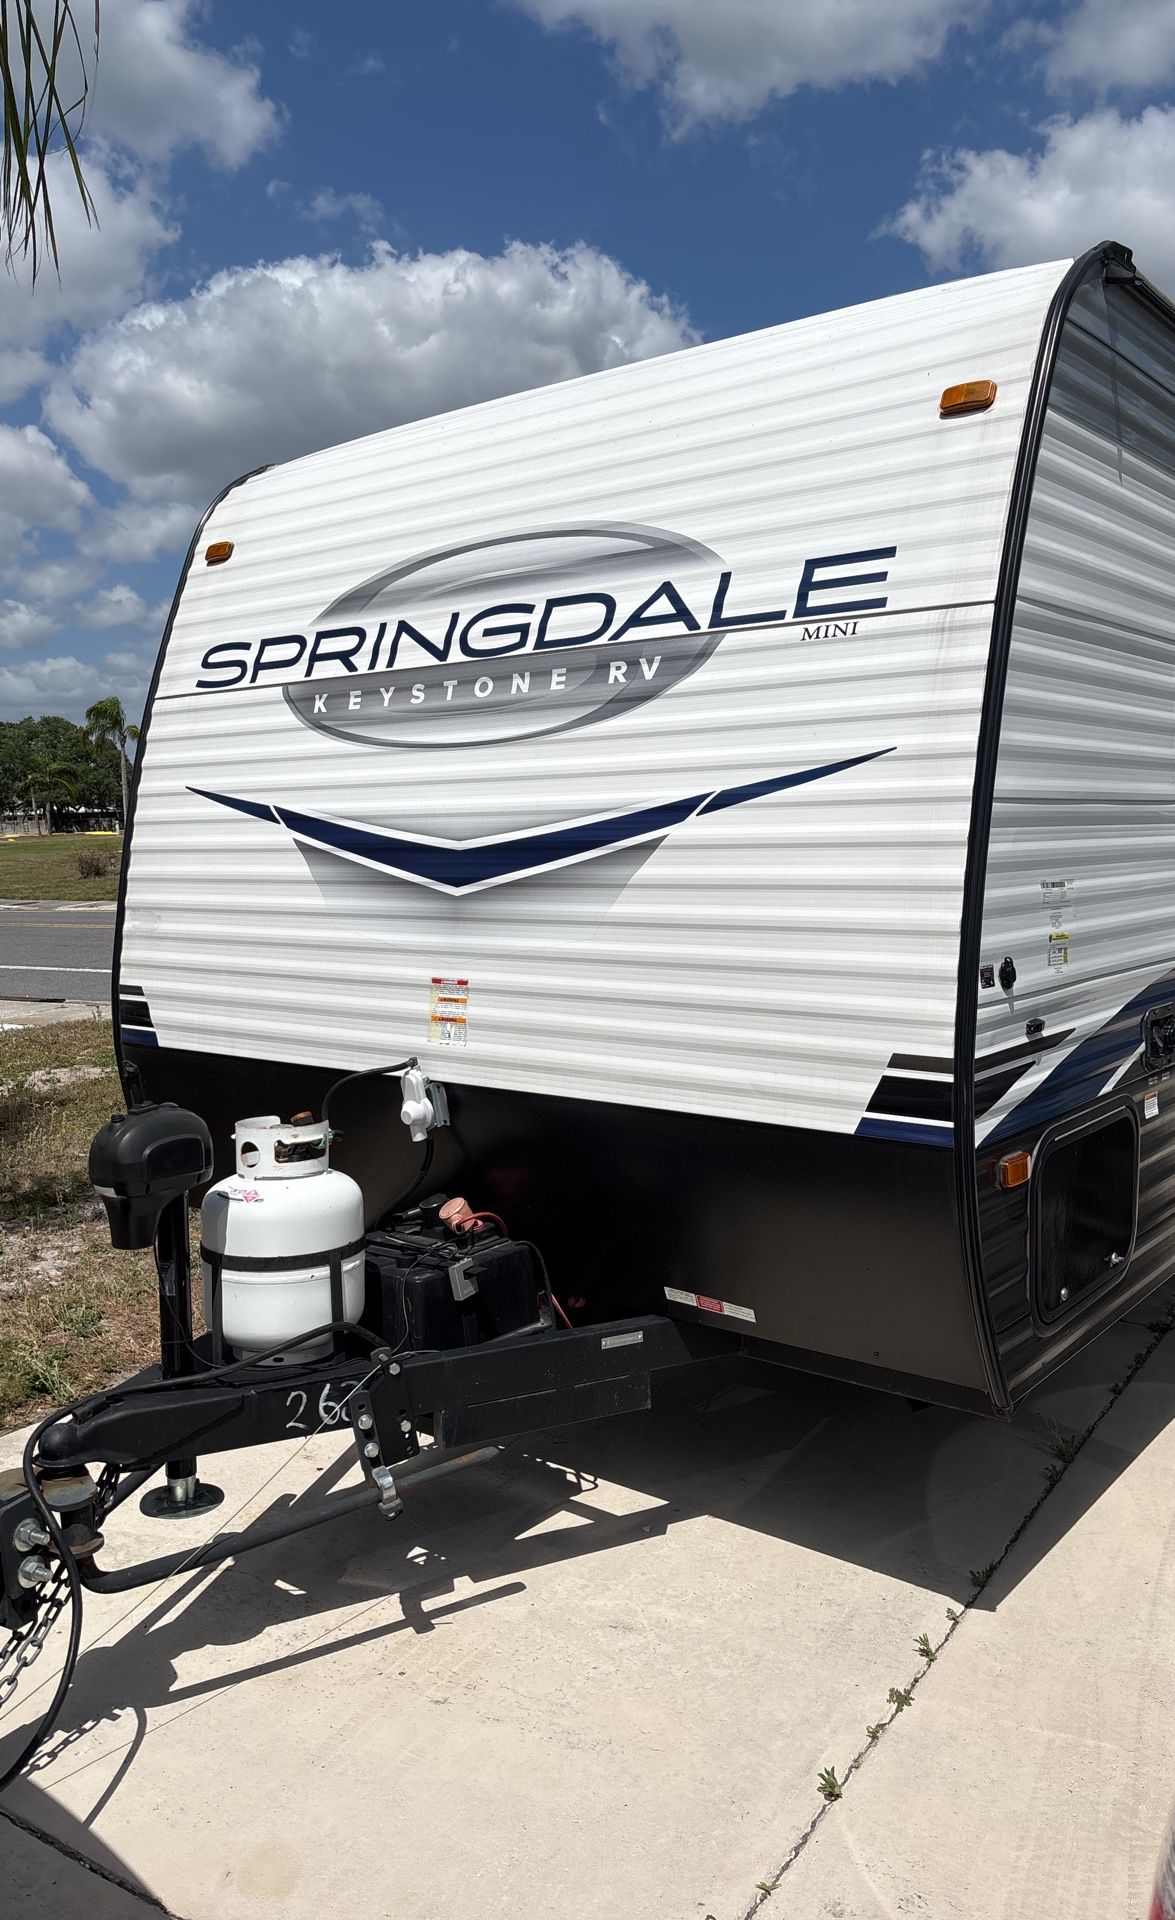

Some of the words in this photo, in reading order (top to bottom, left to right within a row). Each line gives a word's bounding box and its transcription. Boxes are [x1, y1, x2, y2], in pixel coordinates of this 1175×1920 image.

[196, 545, 897, 688] SPRINGDALE
[800, 622, 860, 641] MINI
[313, 667, 567, 714] KEYSTONE
[608, 656, 662, 684] RV
